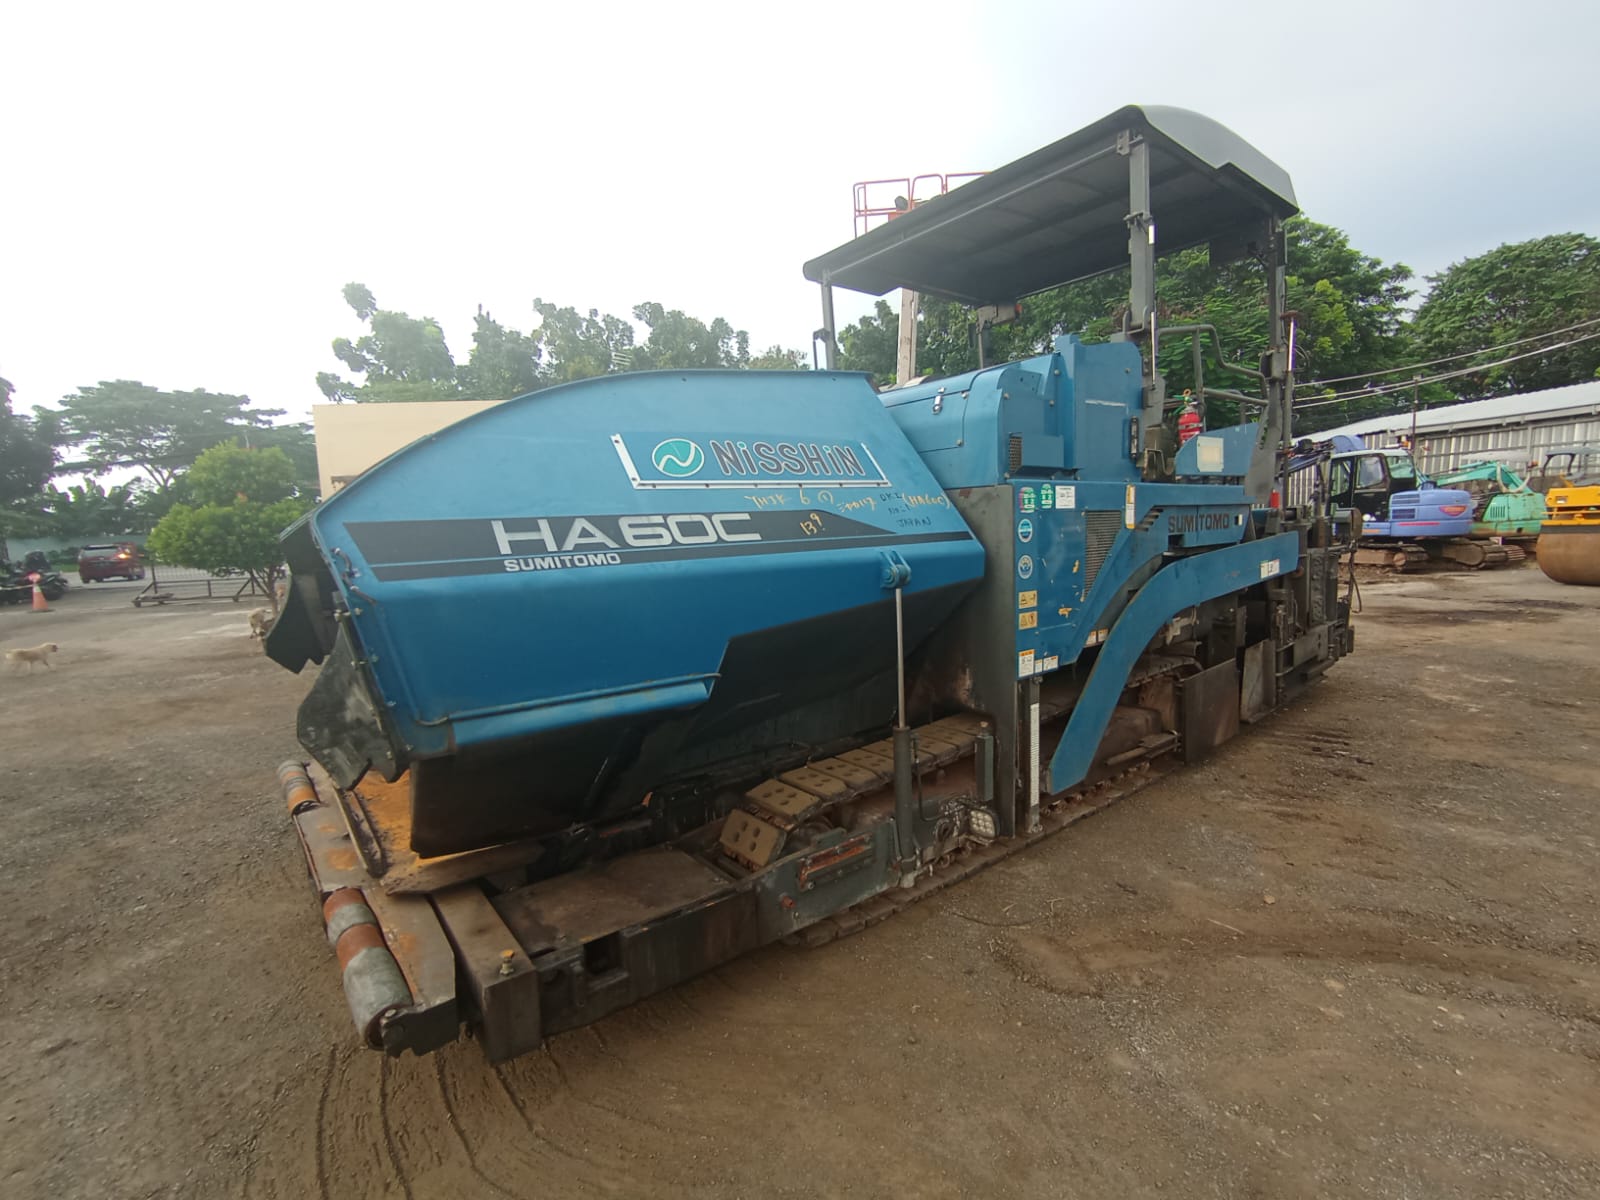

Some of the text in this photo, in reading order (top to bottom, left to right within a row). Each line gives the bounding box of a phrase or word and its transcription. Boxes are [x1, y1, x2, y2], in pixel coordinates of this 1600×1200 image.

[491, 512, 762, 555] HA60C
[1167, 513, 1230, 534] SUMITOMO
[503, 552, 622, 573] SUMITOMO
